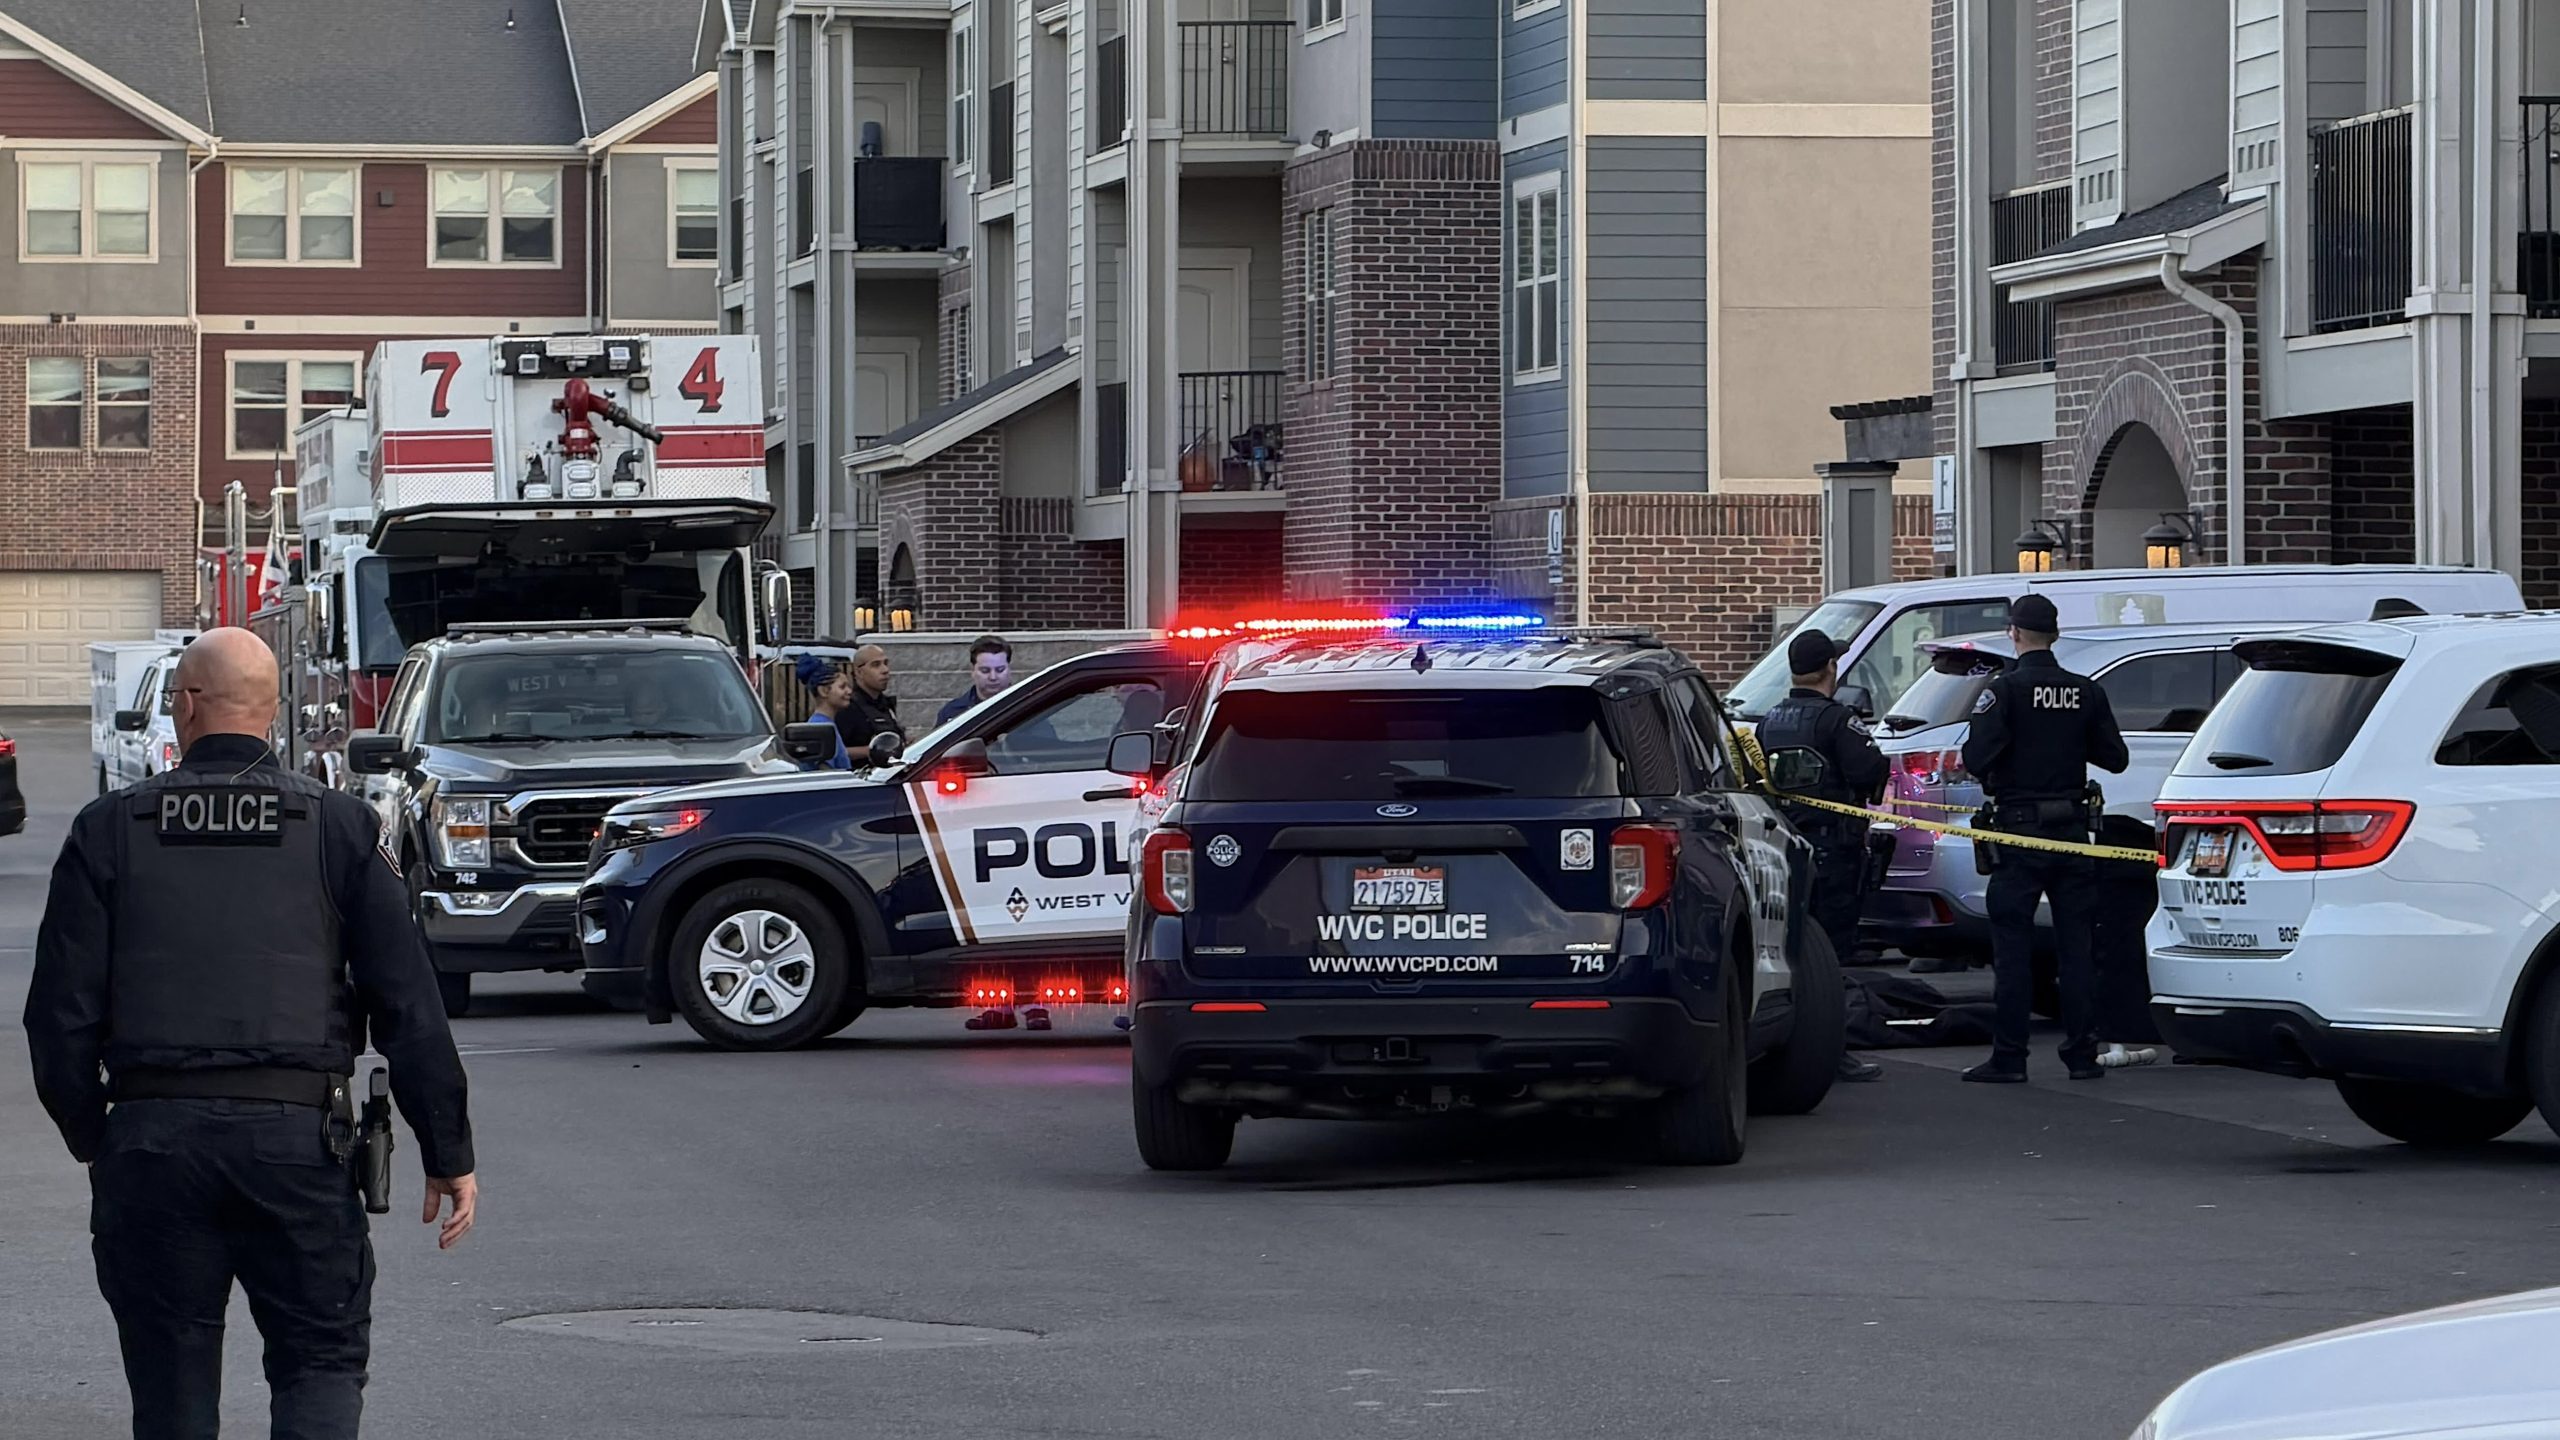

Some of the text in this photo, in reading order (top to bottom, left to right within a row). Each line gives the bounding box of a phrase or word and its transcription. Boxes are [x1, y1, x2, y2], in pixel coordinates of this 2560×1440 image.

[420, 351, 462, 418] 7
[677, 347, 725, 413] 4
[507, 674, 567, 692] WEST V
[2033, 686, 2080, 709] POLICE
[161, 793, 279, 832] POLICE
[973, 821, 1131, 883] POL
[1207, 846, 1239, 855] POLICE
[455, 872, 478, 885] 742
[1383, 868, 1416, 877] UTAH
[1035, 892, 1131, 910] WEST V
[1357, 881, 1428, 904] 217597
[2181, 881, 2247, 905] WVC POLICE
[1317, 914, 1488, 940] WVC POLICE
[2278, 926, 2299, 943] 806
[1308, 956, 1498, 973] WWW.WVCPD.COM
[1570, 954, 1605, 973] 714
